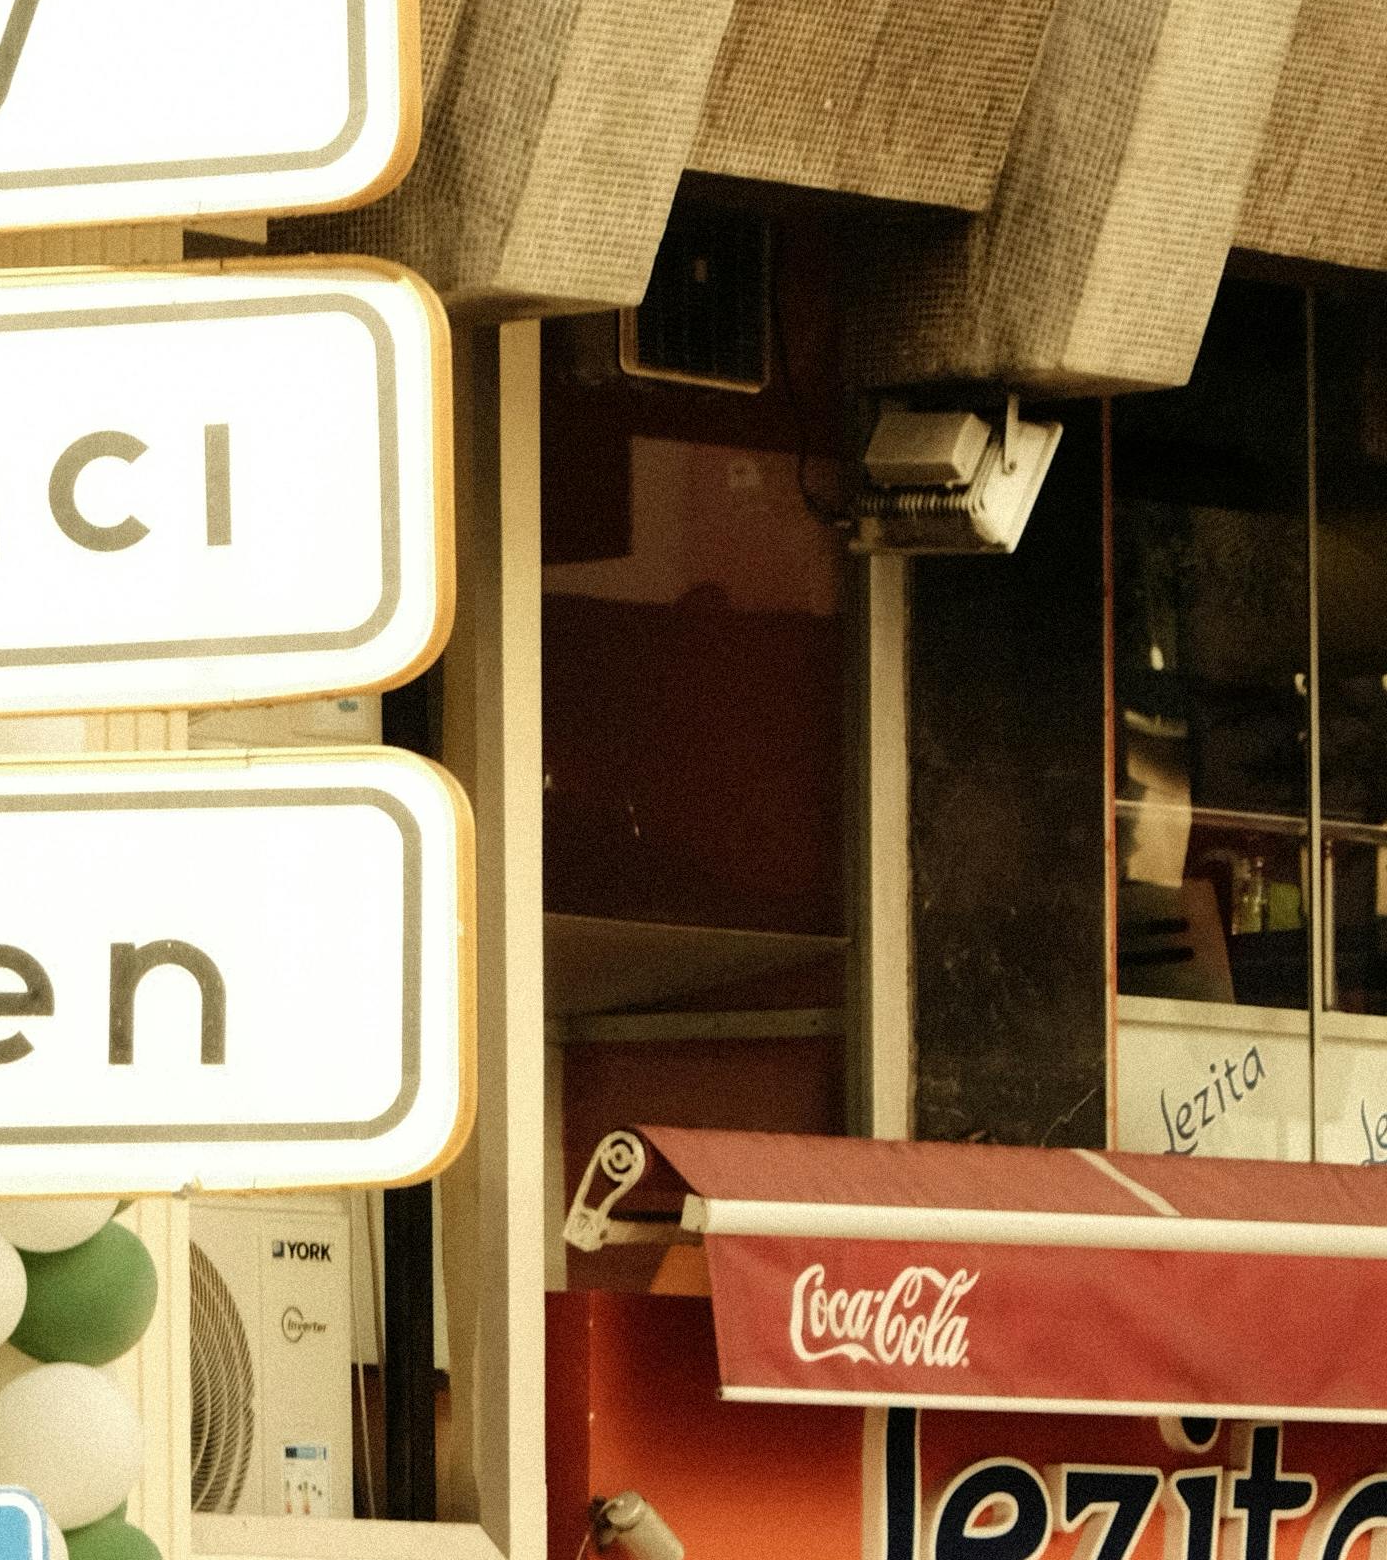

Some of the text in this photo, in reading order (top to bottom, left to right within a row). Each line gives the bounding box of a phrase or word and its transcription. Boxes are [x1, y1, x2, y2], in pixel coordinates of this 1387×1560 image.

[1161, 1046, 1266, 1155] Lezita
[287, 1241, 331, 1262] YORK
[790, 1263, 981, 1368] Coca-Cola
